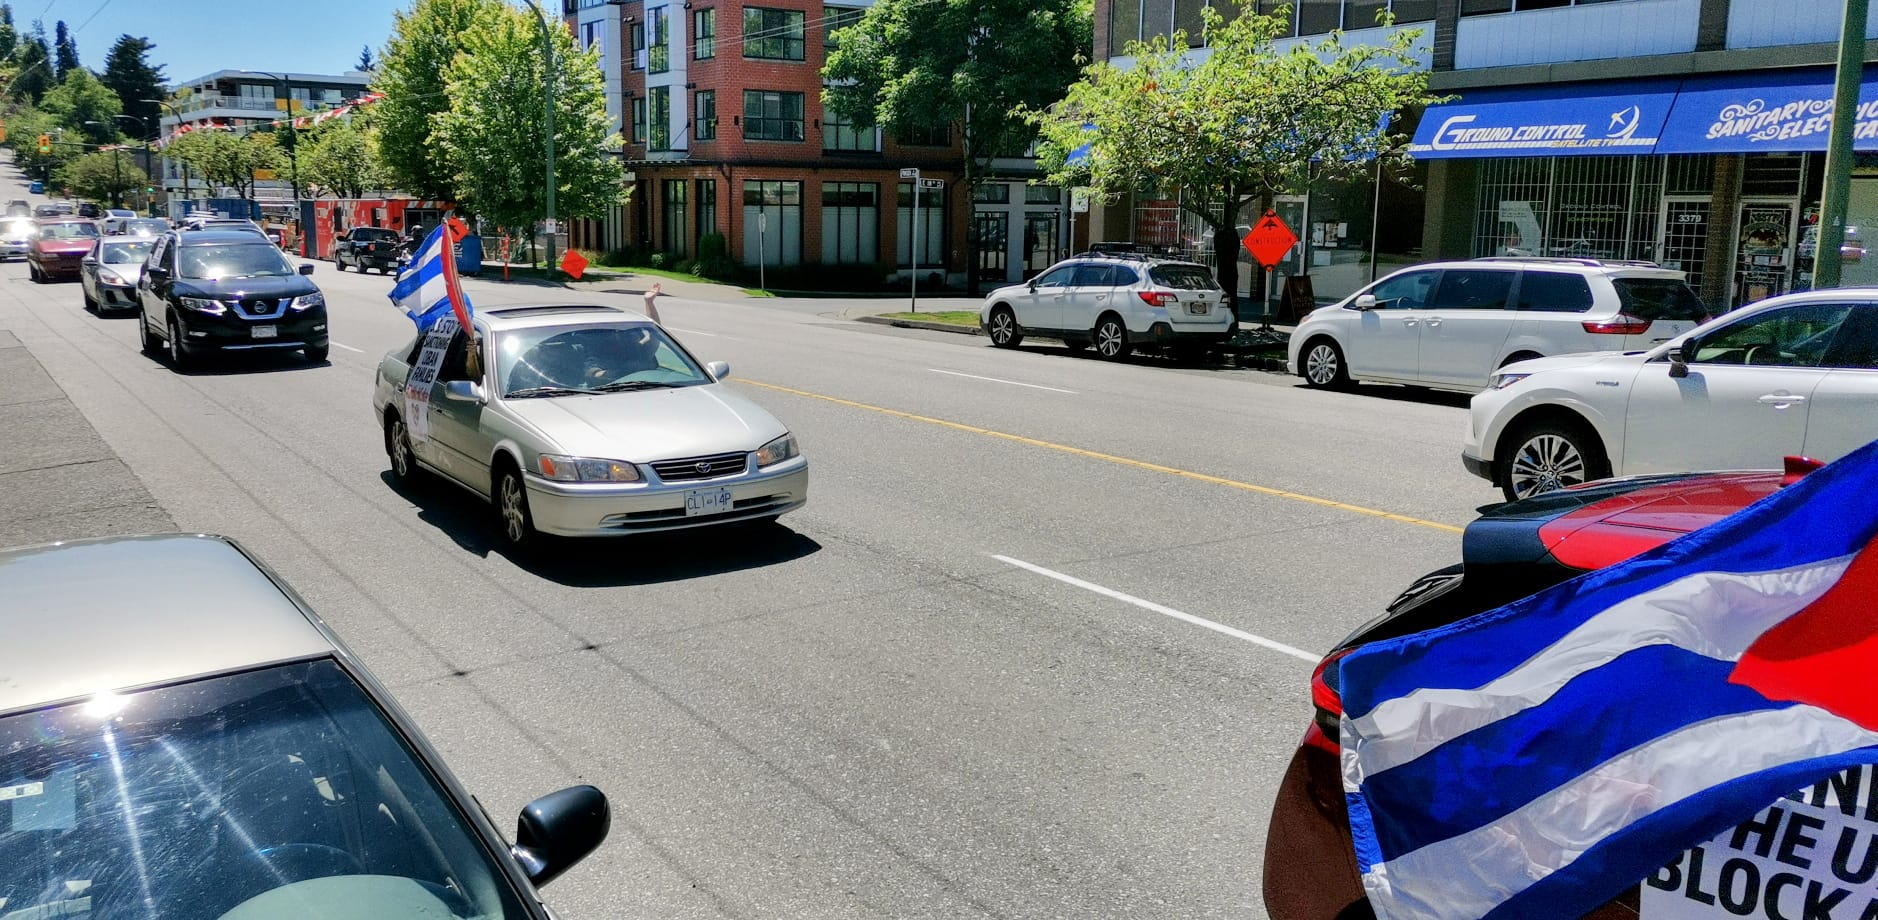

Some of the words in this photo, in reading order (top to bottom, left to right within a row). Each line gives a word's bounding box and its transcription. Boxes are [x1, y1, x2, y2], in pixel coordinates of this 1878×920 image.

[1431, 115, 1513, 150] GROUND
[1511, 124, 1587, 140] CONTROL
[1705, 99, 1812, 140] SANITARY
[1678, 214, 1702, 223] 3379
